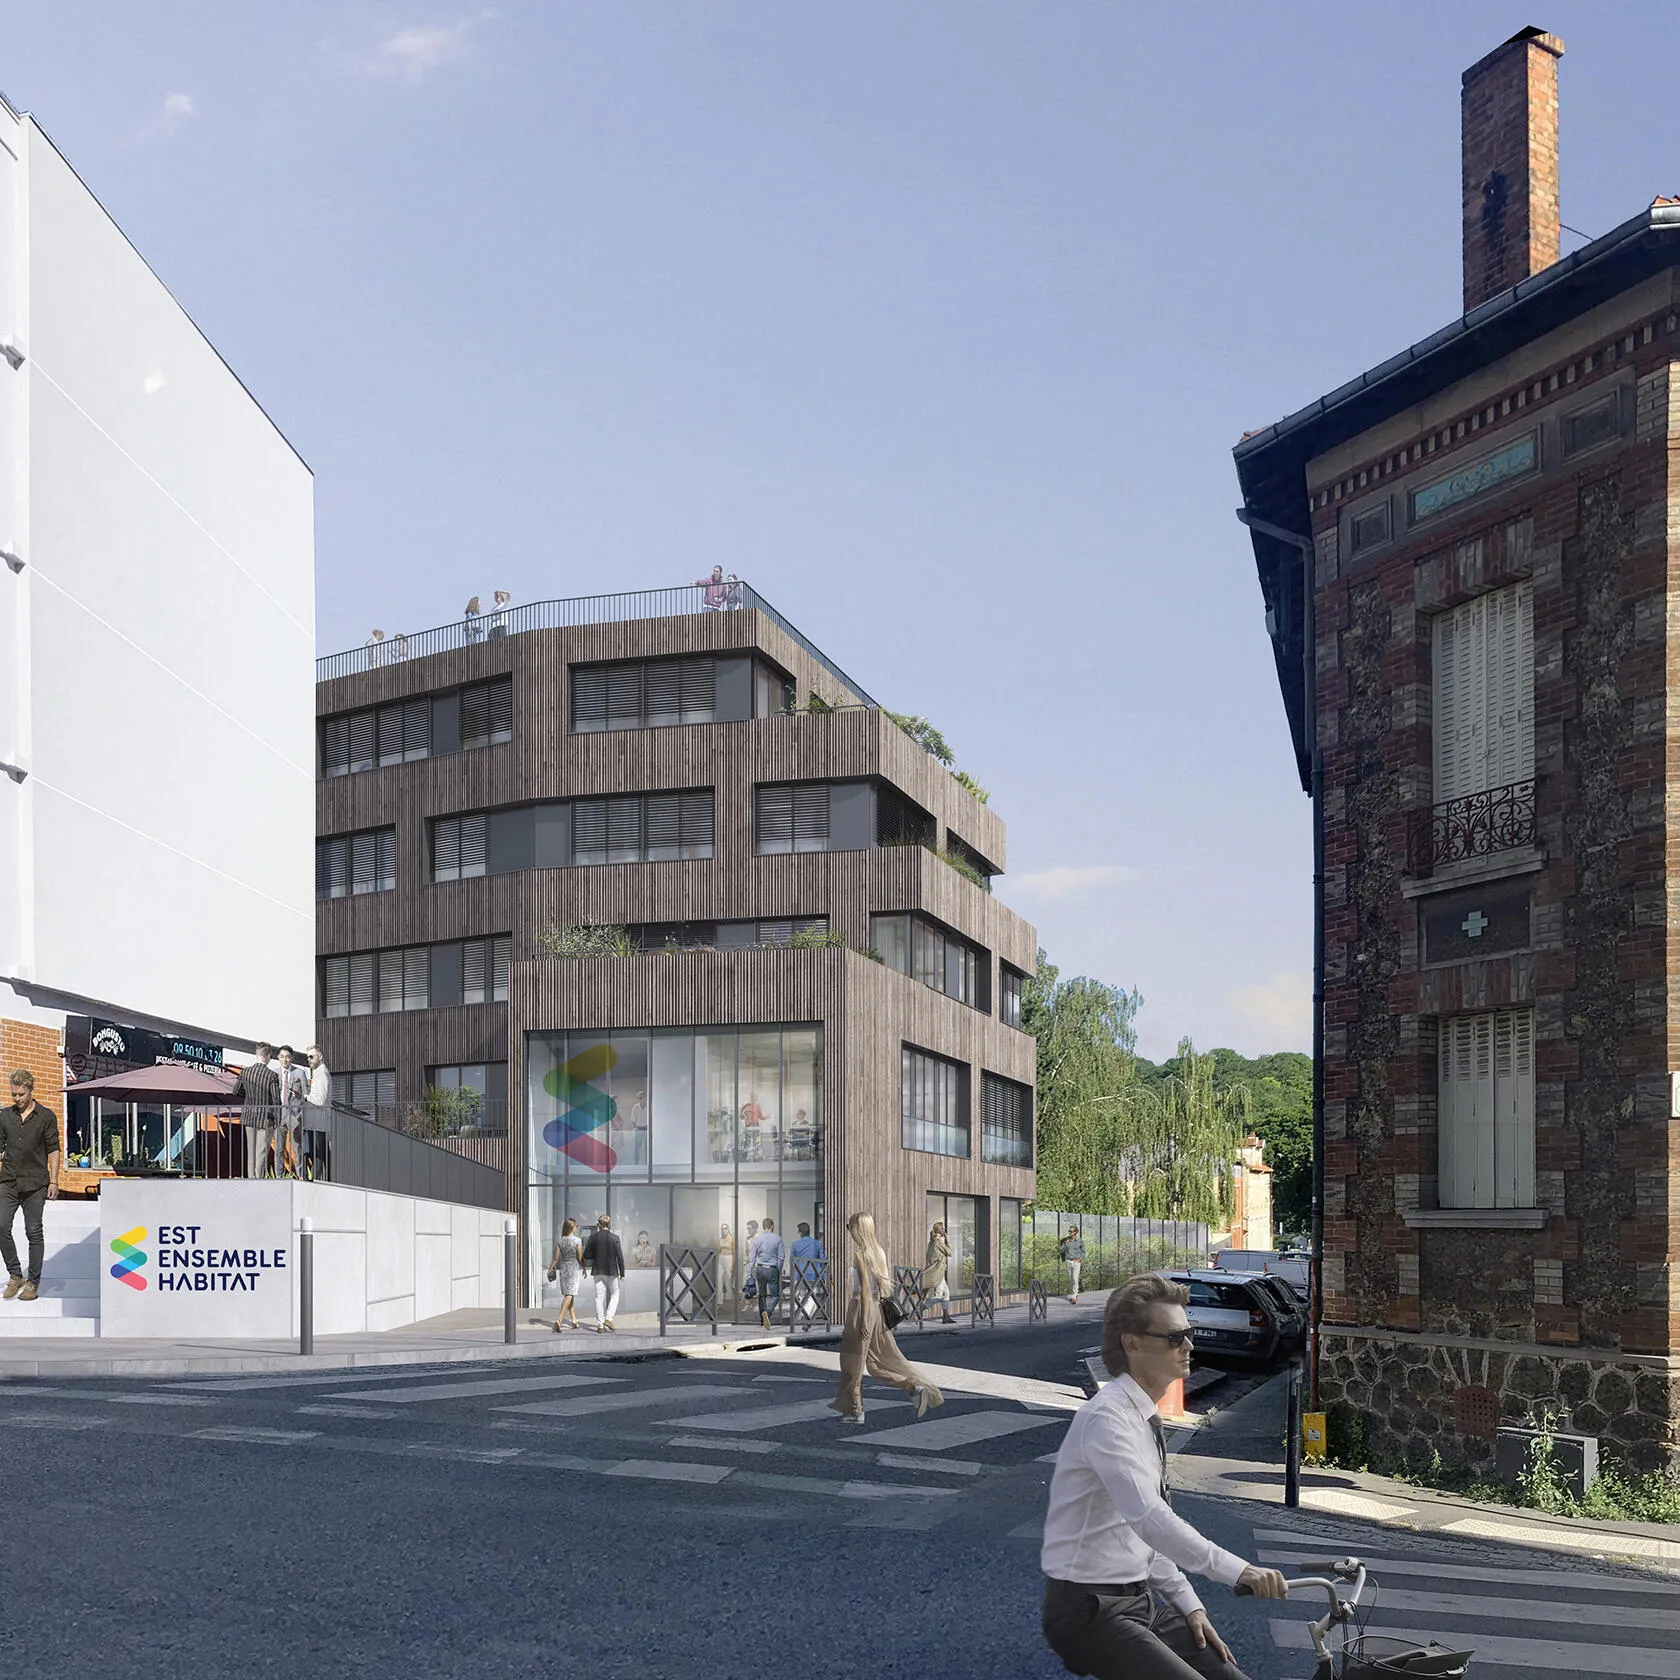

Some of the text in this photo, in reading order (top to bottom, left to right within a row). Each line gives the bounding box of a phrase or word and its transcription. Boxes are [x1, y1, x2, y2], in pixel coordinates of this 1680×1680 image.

[214, 1050, 222, 1063] 26
[158, 1226, 201, 1245] EST
[158, 1249, 287, 1268] ENSEMBLE
[158, 1272, 261, 1291] HABITAT
